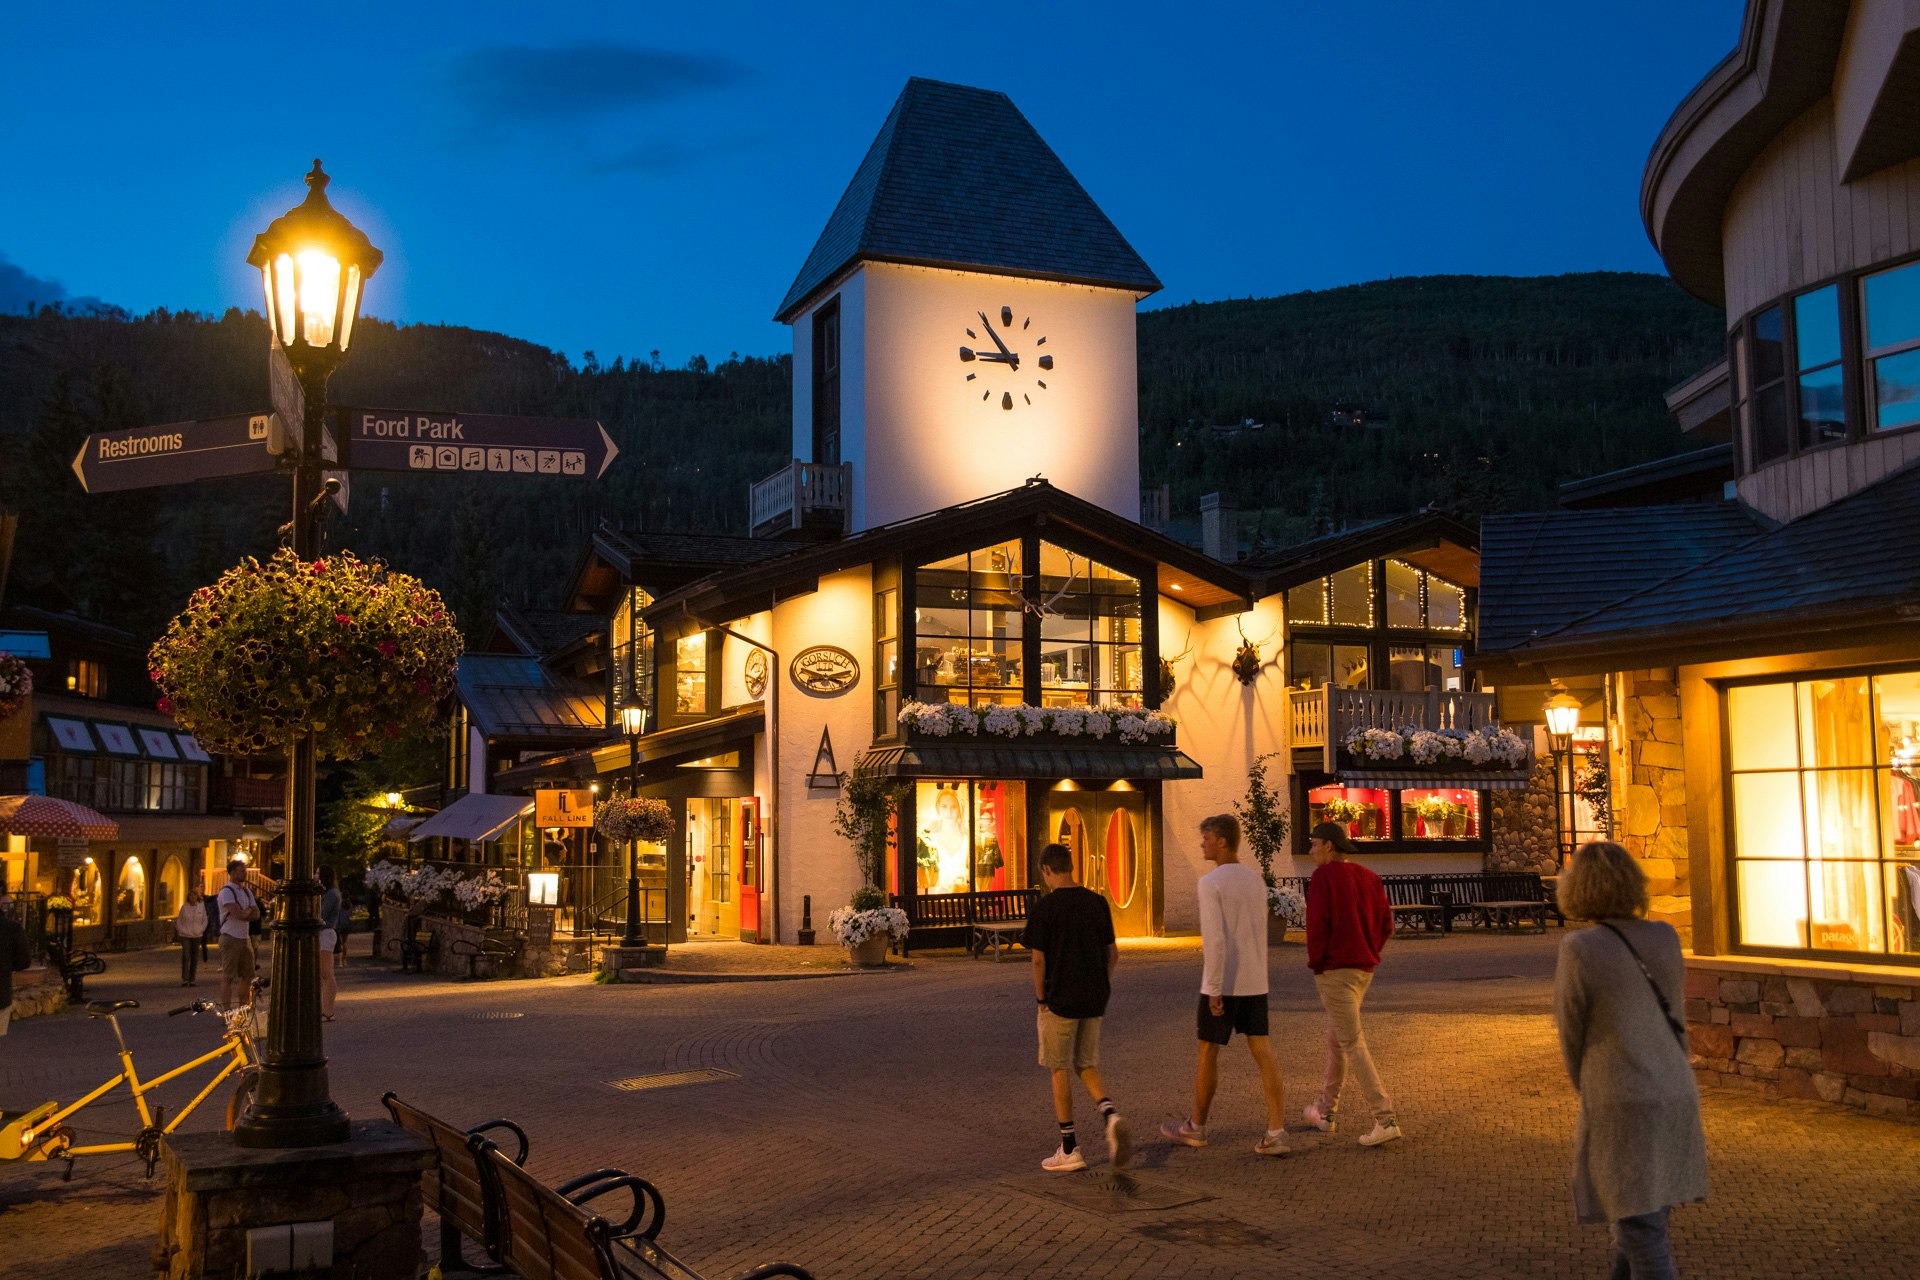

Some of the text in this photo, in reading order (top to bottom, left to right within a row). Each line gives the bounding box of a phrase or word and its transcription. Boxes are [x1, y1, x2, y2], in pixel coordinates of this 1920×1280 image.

[362, 414, 464, 439] Ford Park
[99, 432, 183, 459] Restrooms
[801, 651, 851, 668] GORSUCH
